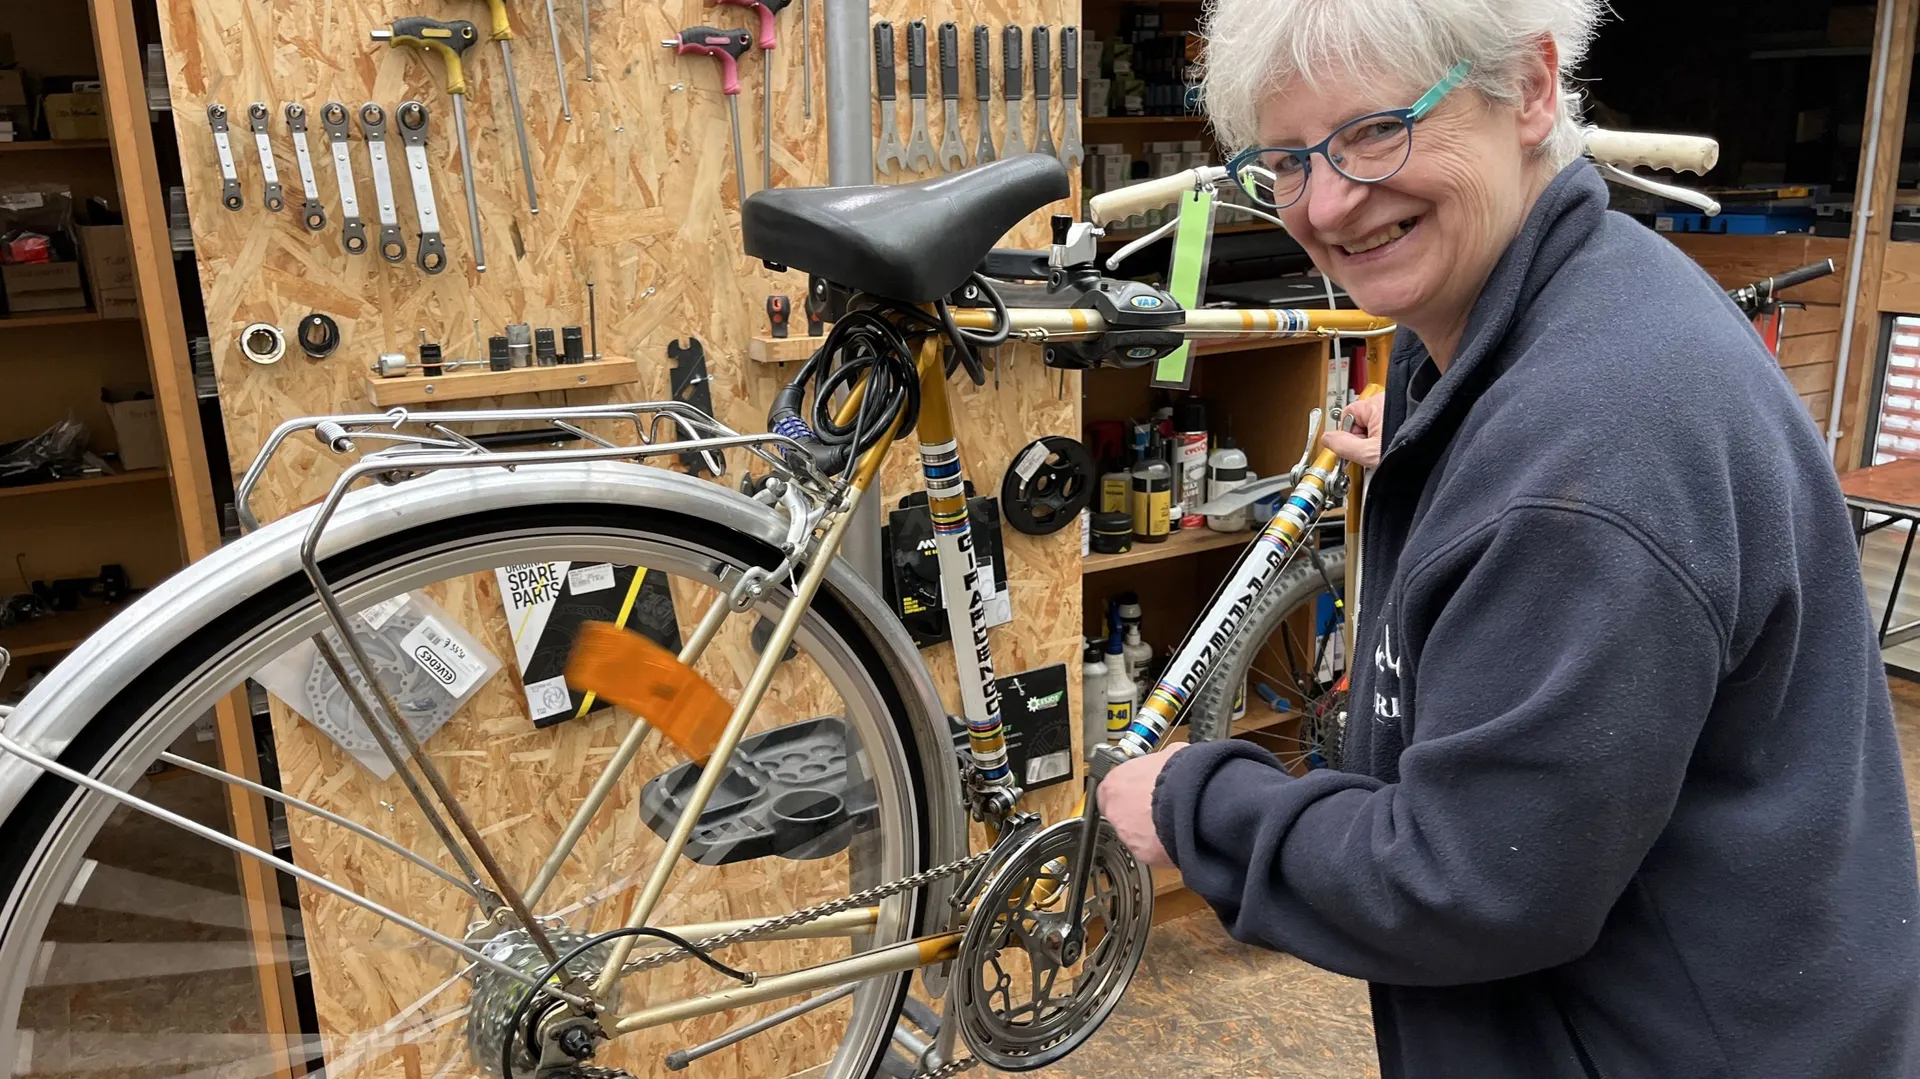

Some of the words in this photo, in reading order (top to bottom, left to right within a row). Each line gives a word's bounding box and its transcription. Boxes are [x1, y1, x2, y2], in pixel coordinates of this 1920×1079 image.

[1137, 298, 1157, 307] VAR
[508, 563, 558, 591] SPARE
[512, 581, 560, 609] PARTS
[1181, 551, 1282, 693] GIRARDENGO
[420, 650, 453, 681] ELVEDES
[1107, 709, 1127, 720] D-40
